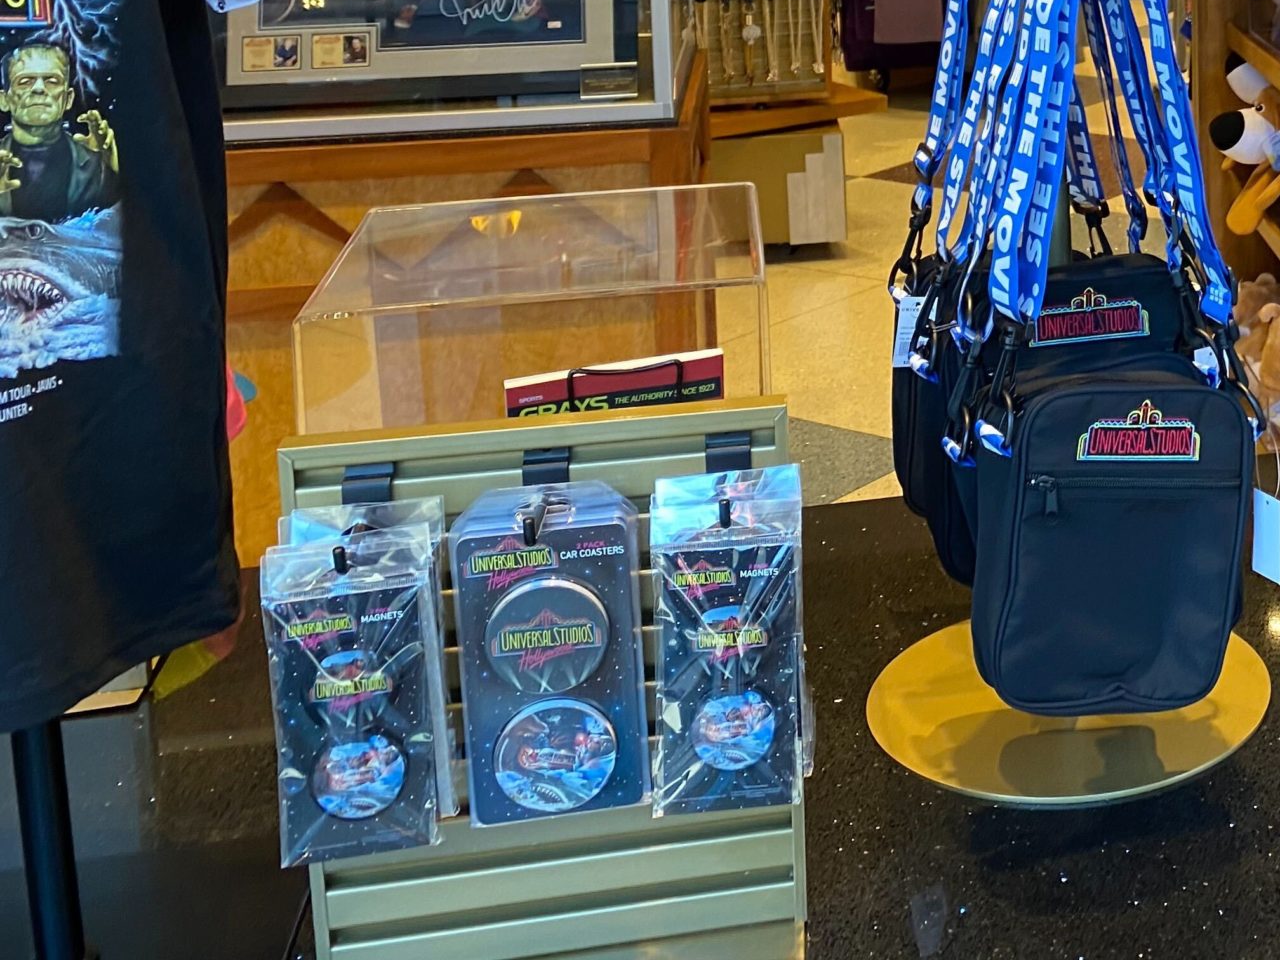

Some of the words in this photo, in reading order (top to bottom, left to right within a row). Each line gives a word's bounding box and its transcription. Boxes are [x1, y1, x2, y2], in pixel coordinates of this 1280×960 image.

[958, 66, 986, 147] THE
[1018, 65, 1047, 157] THE
[1073, 131, 1099, 198] THE
[519, 395, 543, 404] SPORTS
[614, 396, 629, 405] THE
[631, 390, 673, 403] AUTHORITY
[560, 550, 578, 560] CAR
[580, 546, 624, 558] COASTERS
[740, 568, 779, 578] MAGNETS
[361, 611, 403, 622] MAGNETS
